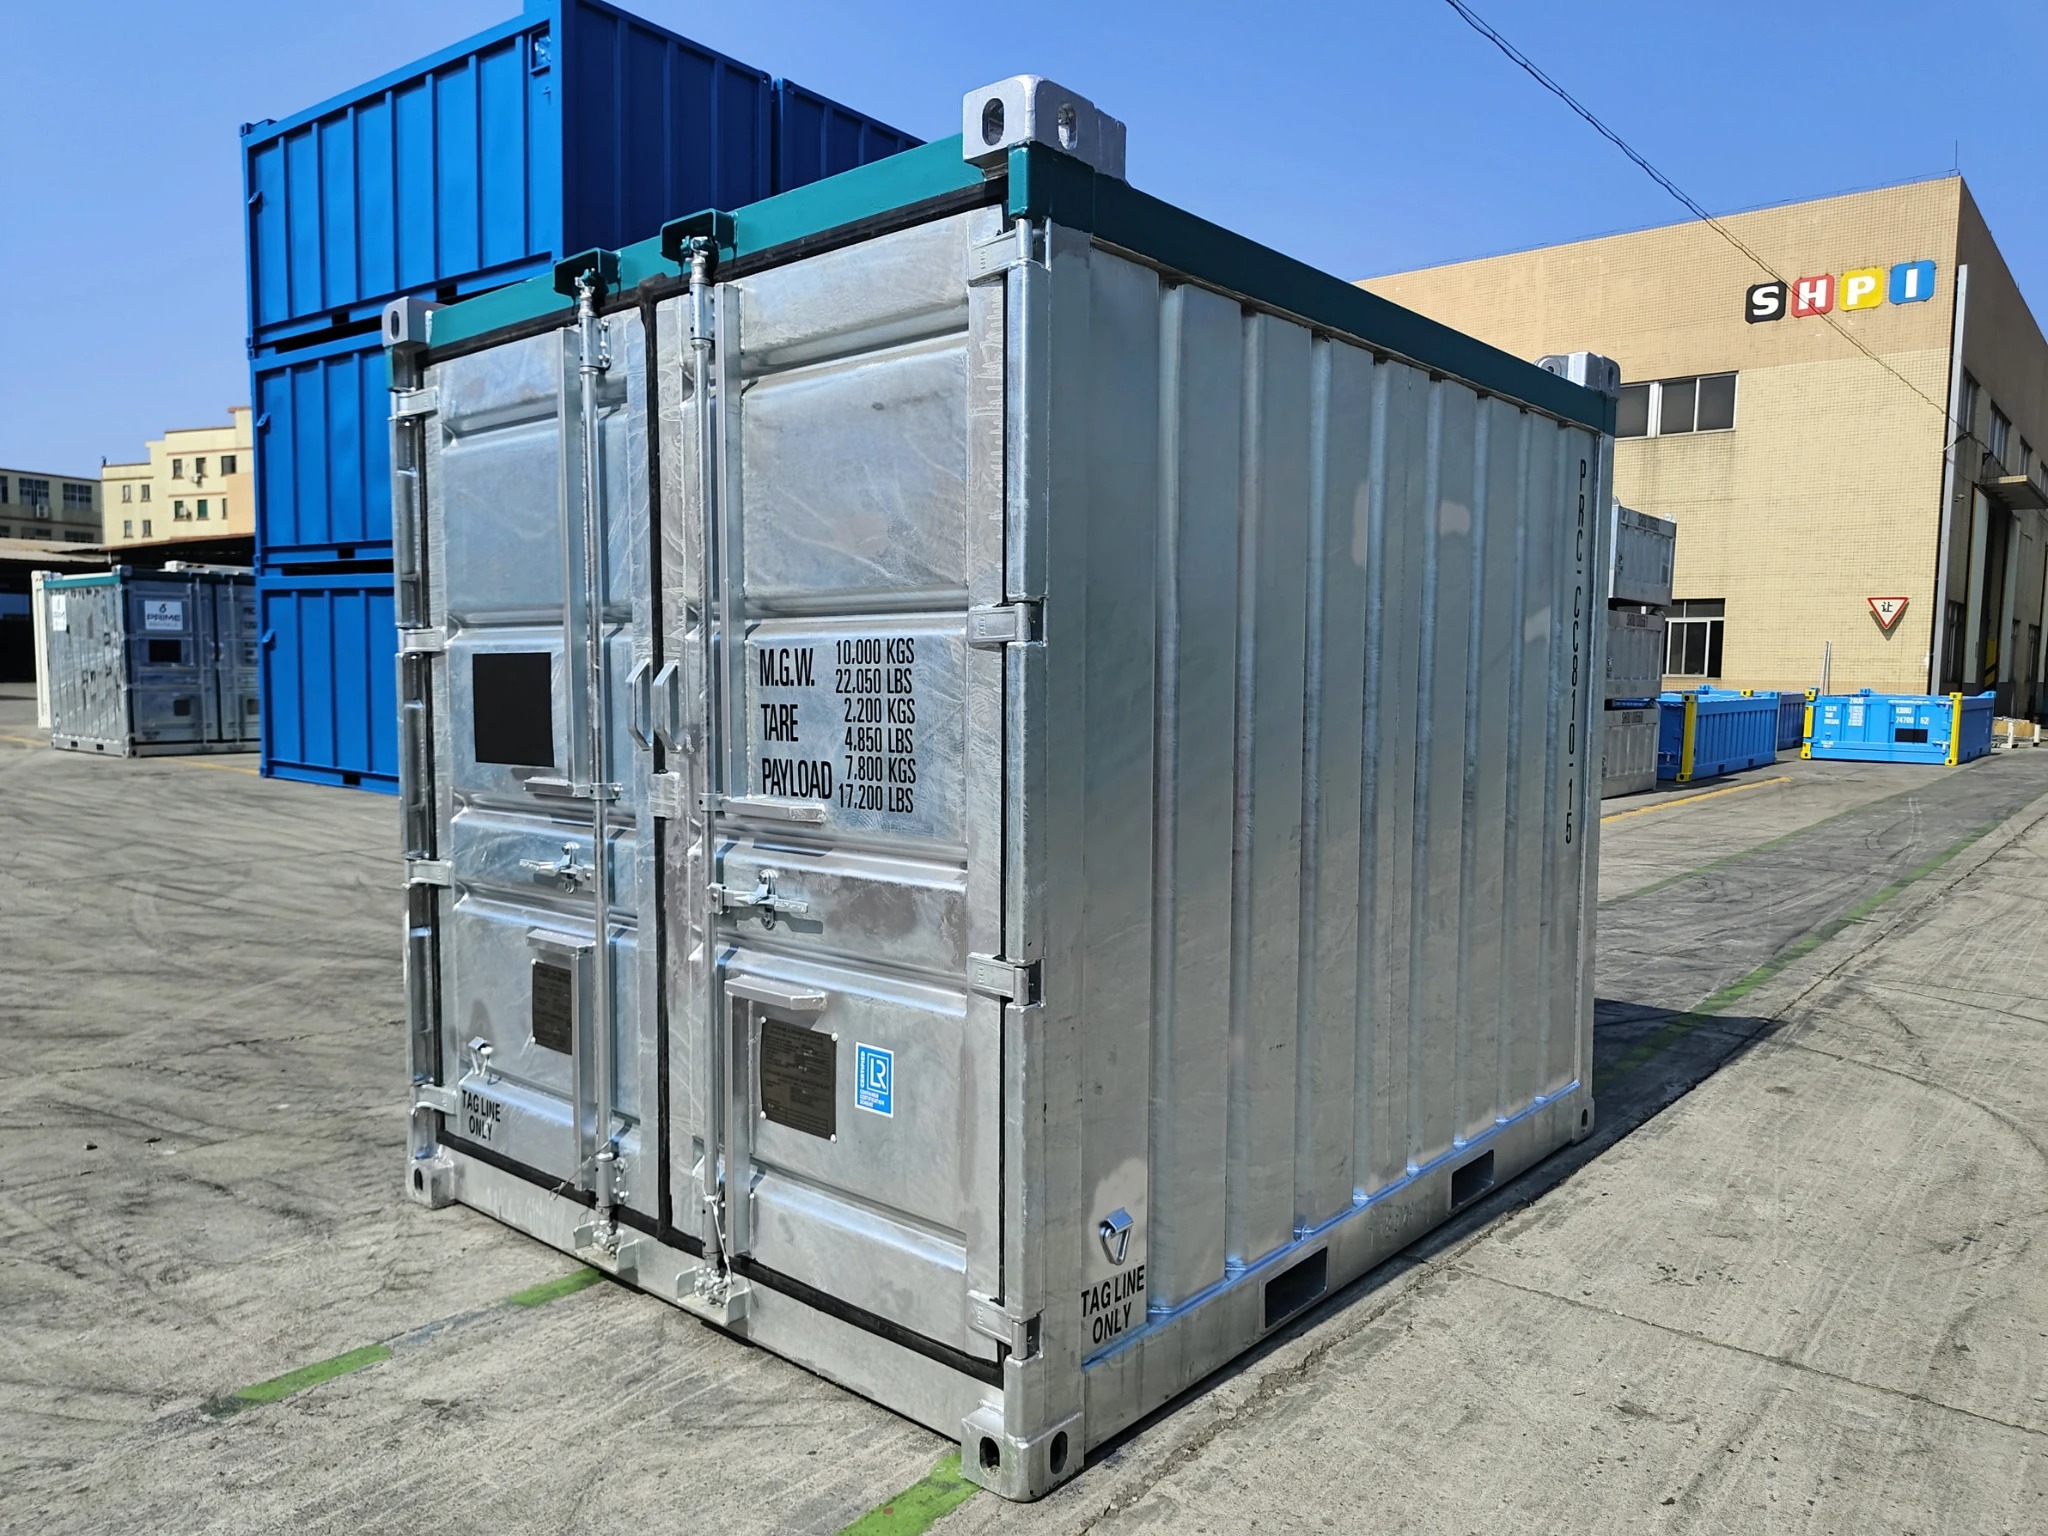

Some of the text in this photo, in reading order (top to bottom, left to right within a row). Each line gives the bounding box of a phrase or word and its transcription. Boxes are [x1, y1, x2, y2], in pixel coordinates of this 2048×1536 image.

[1752, 268, 1918, 316] SHPI
[147, 613, 182, 622] PRIME
[1881, 601, 1893, 613] 让
[836, 638, 915, 665] 10,000 KGS
[760, 648, 815, 686] M.G.W.
[835, 668, 913, 694] 22,050 LBS
[761, 704, 799, 742] TARE
[844, 698, 915, 724] 2,200 KGS
[844, 727, 913, 754] 4,850 LBS
[761, 758, 833, 799] PAYLOAD
[845, 755, 916, 784] 7,800 KGS
[838, 783, 914, 813] 17,200 LBS
[870, 1057, 887, 1090] LR
[462, 1090, 500, 1122] TAG LINE
[468, 1115, 493, 1141] ONLY
[1081, 1264, 1145, 1317] TAG LINE
[1092, 1302, 1132, 1344] ONLY
